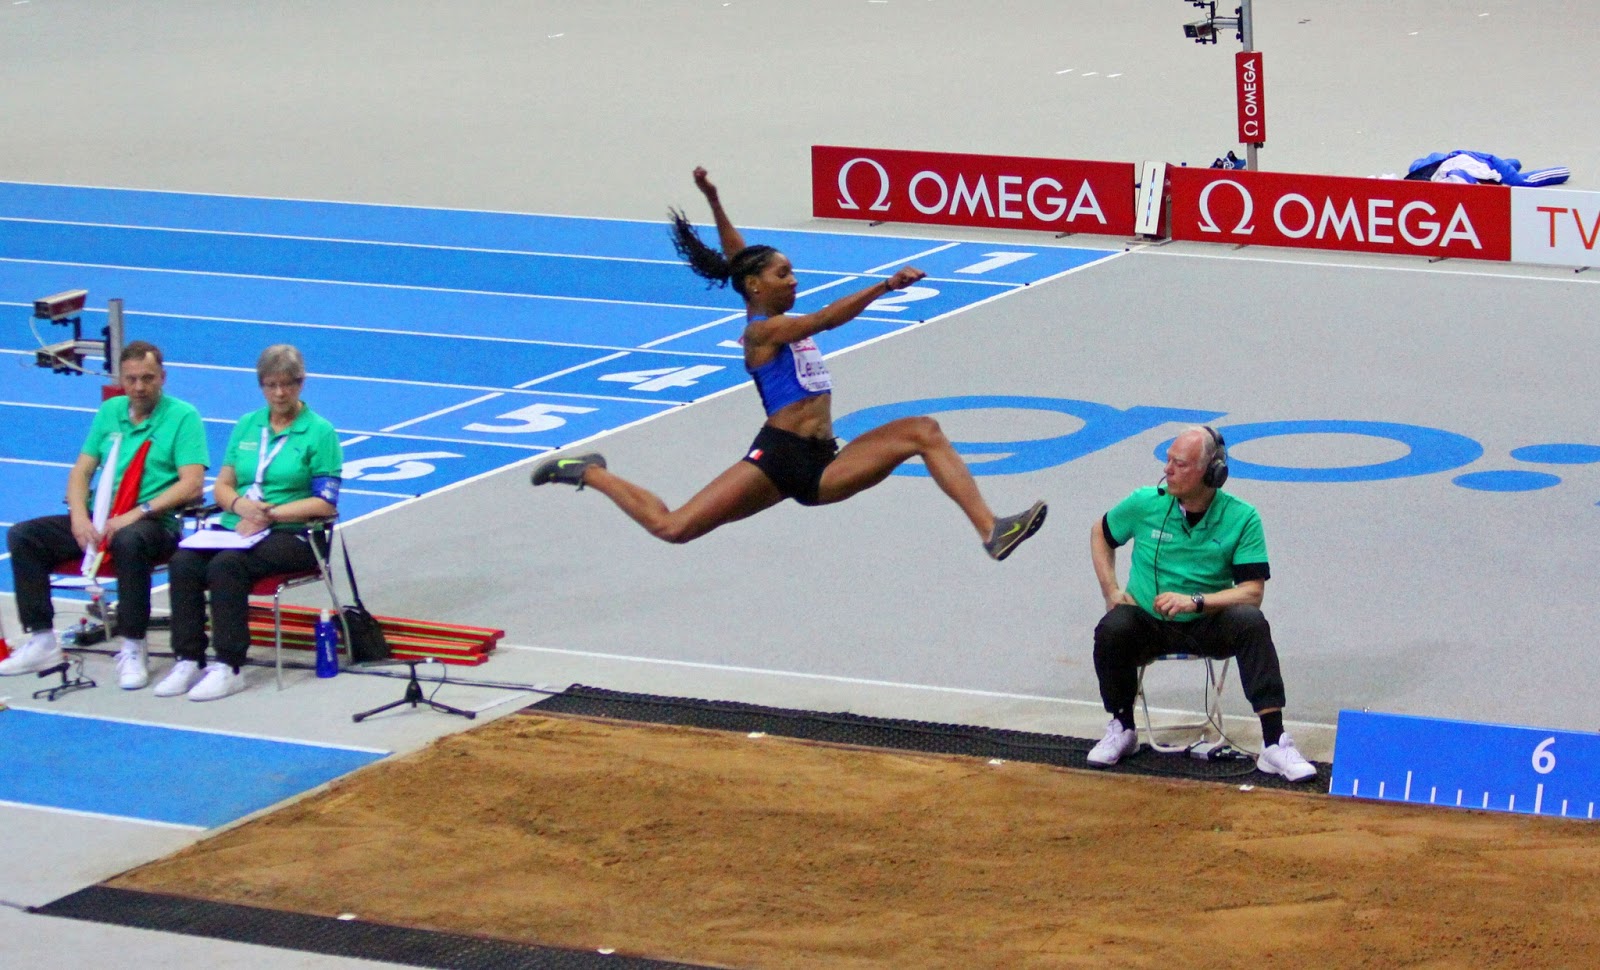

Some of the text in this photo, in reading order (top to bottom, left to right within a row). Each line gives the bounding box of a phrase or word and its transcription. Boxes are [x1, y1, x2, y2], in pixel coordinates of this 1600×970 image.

[1242, 58, 1258, 117] OMEGA
[908, 170, 1107, 225] OMEGA
[1272, 192, 1483, 250] OMEGA
[1536, 205, 1600, 250] TV
[953, 251, 1039, 275] 1
[864, 285, 941, 313] 2
[596, 364, 728, 392] 4
[461, 402, 600, 434] 5
[341, 450, 466, 482] 6
[1531, 736, 1556, 775] 6
